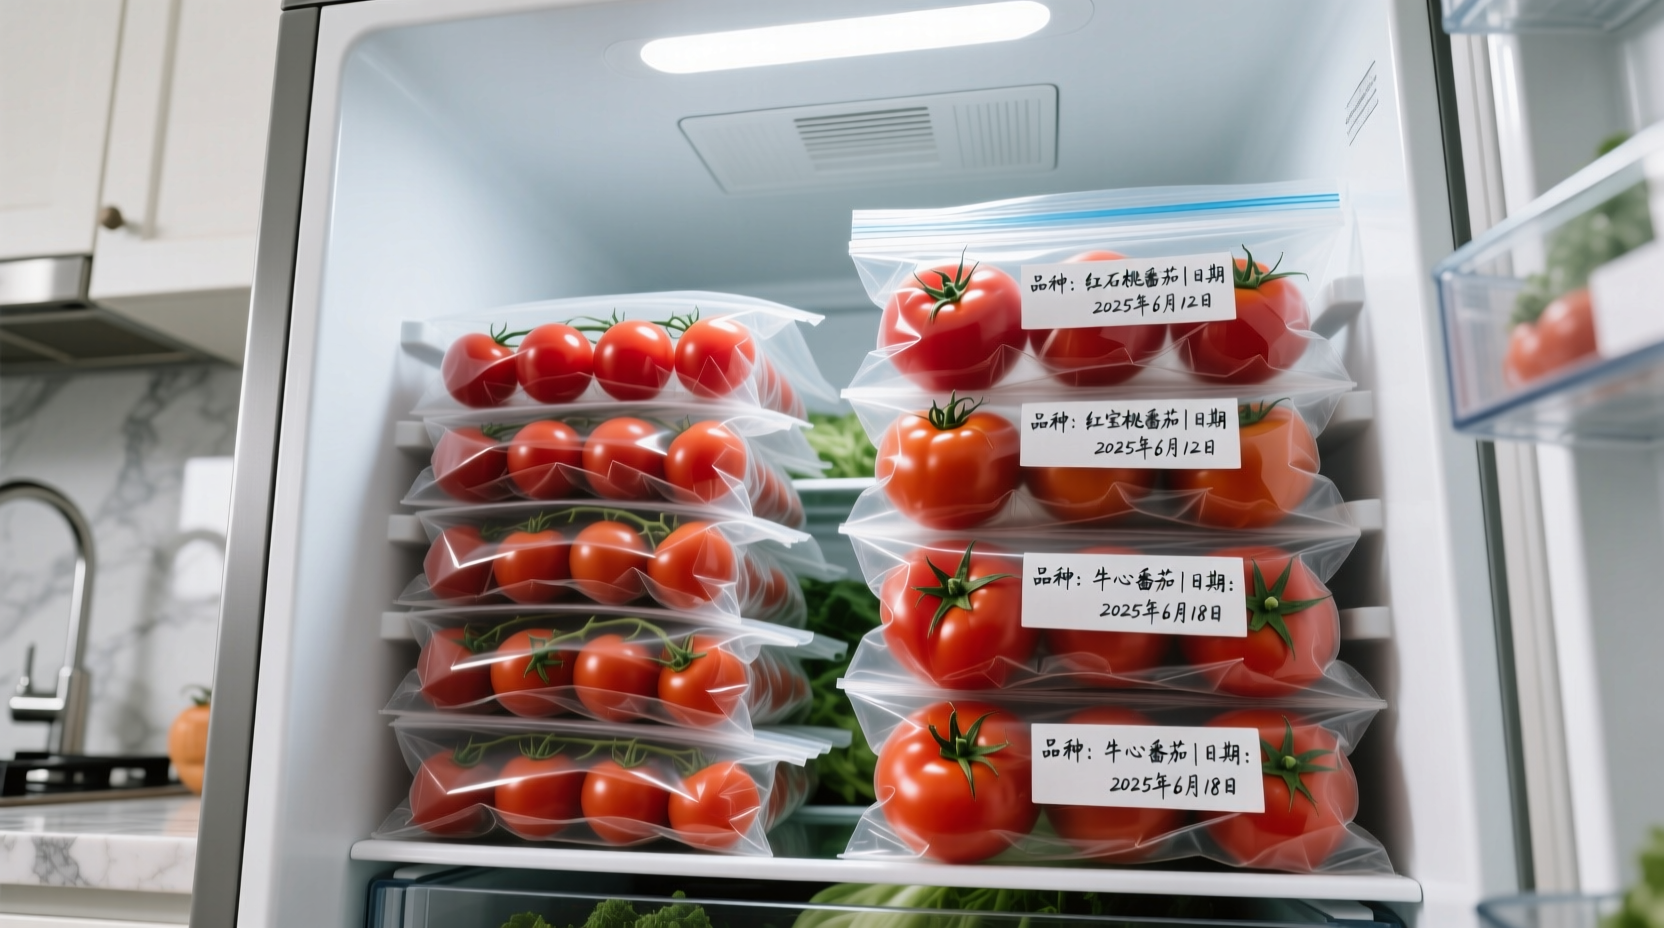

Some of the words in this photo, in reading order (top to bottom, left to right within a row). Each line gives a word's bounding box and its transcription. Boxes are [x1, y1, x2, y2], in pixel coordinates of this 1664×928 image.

[1092, 293, 1211, 316] 2025年6月12日
[1094, 436, 1215, 460] 2025年6月12日
[1099, 599, 1222, 625] 2025年6月18日
[1109, 772, 1236, 800] 2025年6月18日
